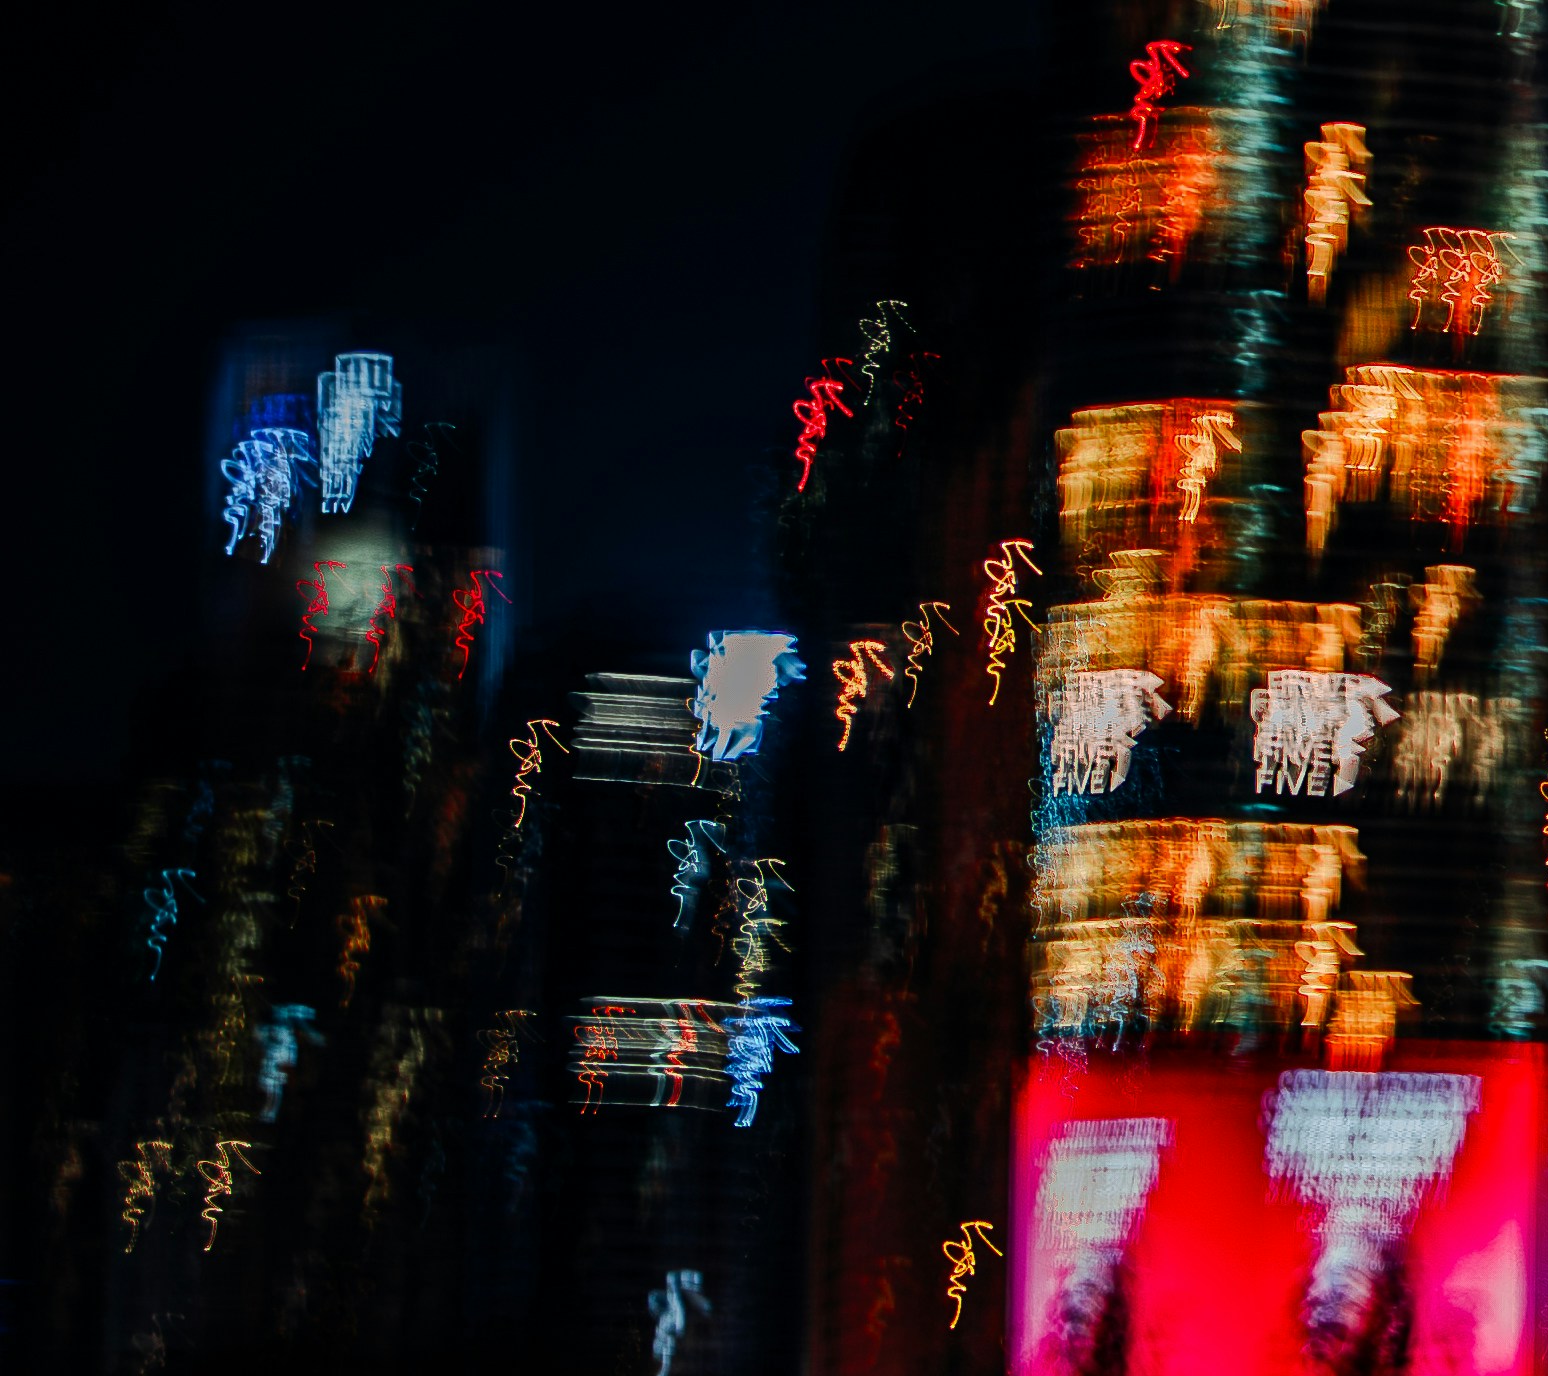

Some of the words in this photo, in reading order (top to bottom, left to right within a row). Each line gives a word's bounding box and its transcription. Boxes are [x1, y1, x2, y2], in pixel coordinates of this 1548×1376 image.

[321, 501, 352, 514] LIV
[1053, 768, 1108, 797] FIVE
[1256, 769, 1328, 797] FIVE
